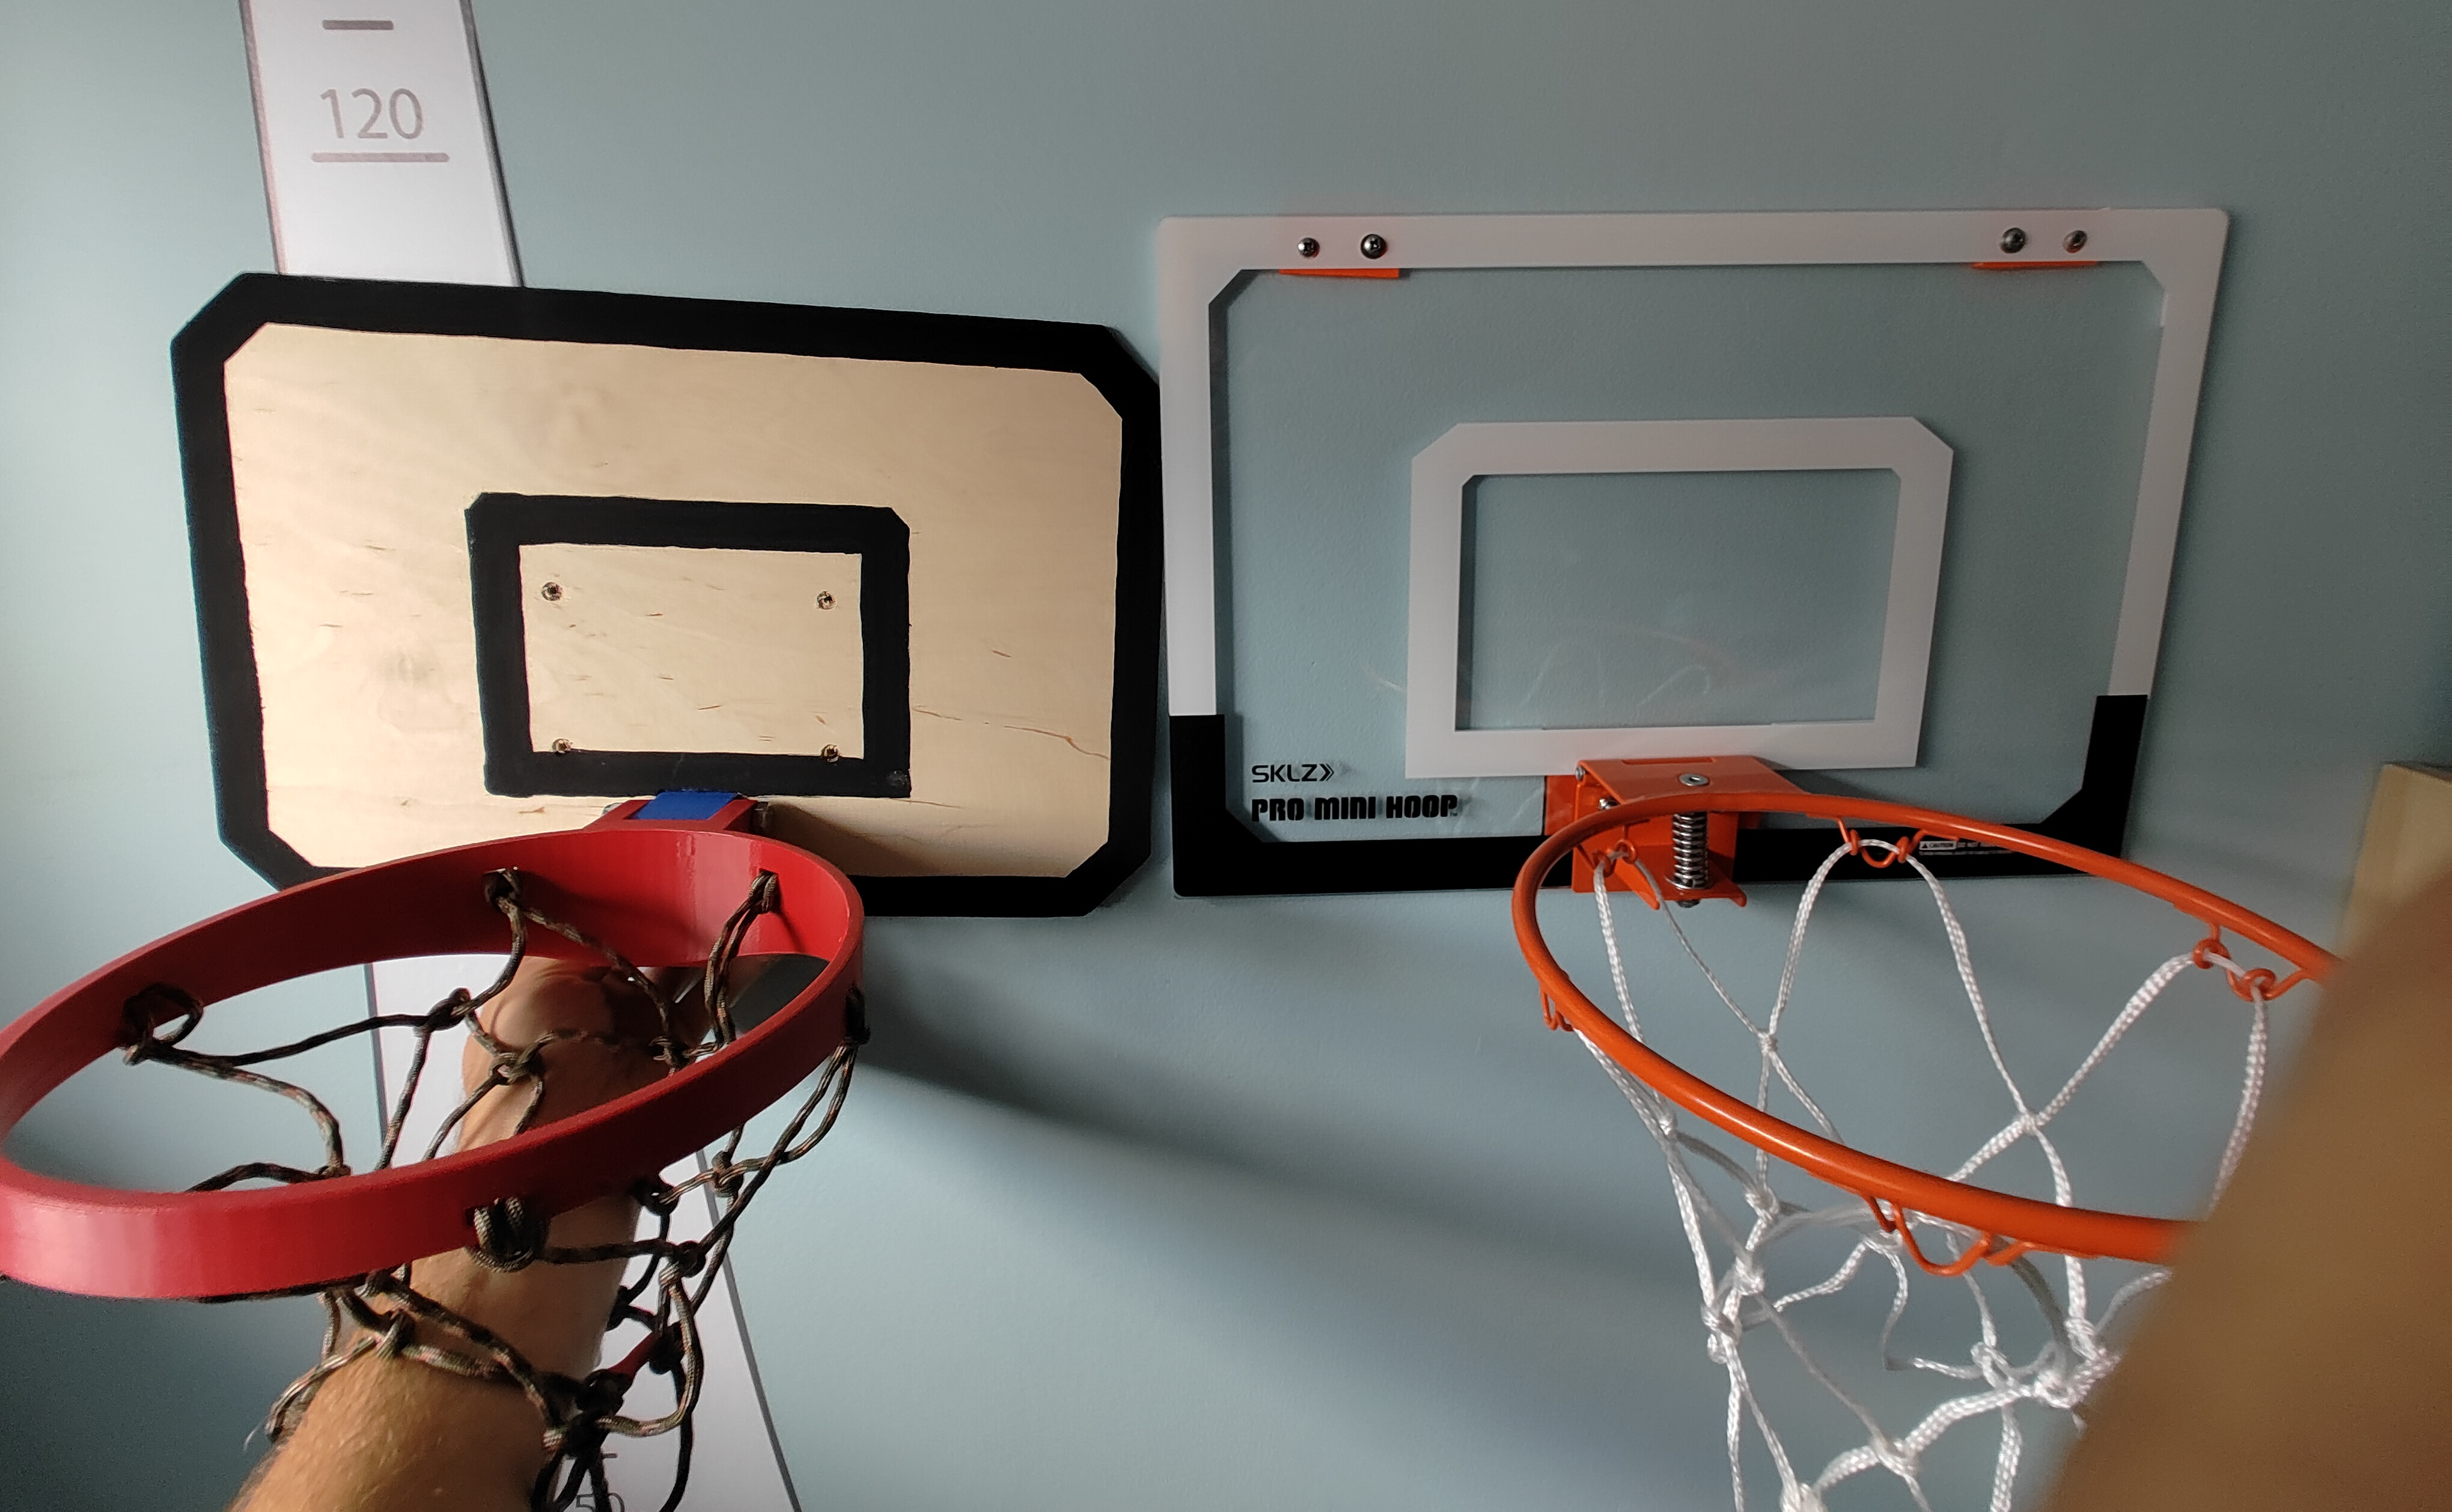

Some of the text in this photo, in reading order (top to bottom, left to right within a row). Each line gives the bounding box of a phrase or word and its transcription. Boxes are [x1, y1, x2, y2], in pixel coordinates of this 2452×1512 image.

[320, 88, 424, 139] 120
[1252, 764, 1317, 782] SKLZ
[1251, 797, 1304, 822] PRO
[1314, 796, 1376, 820] MINI
